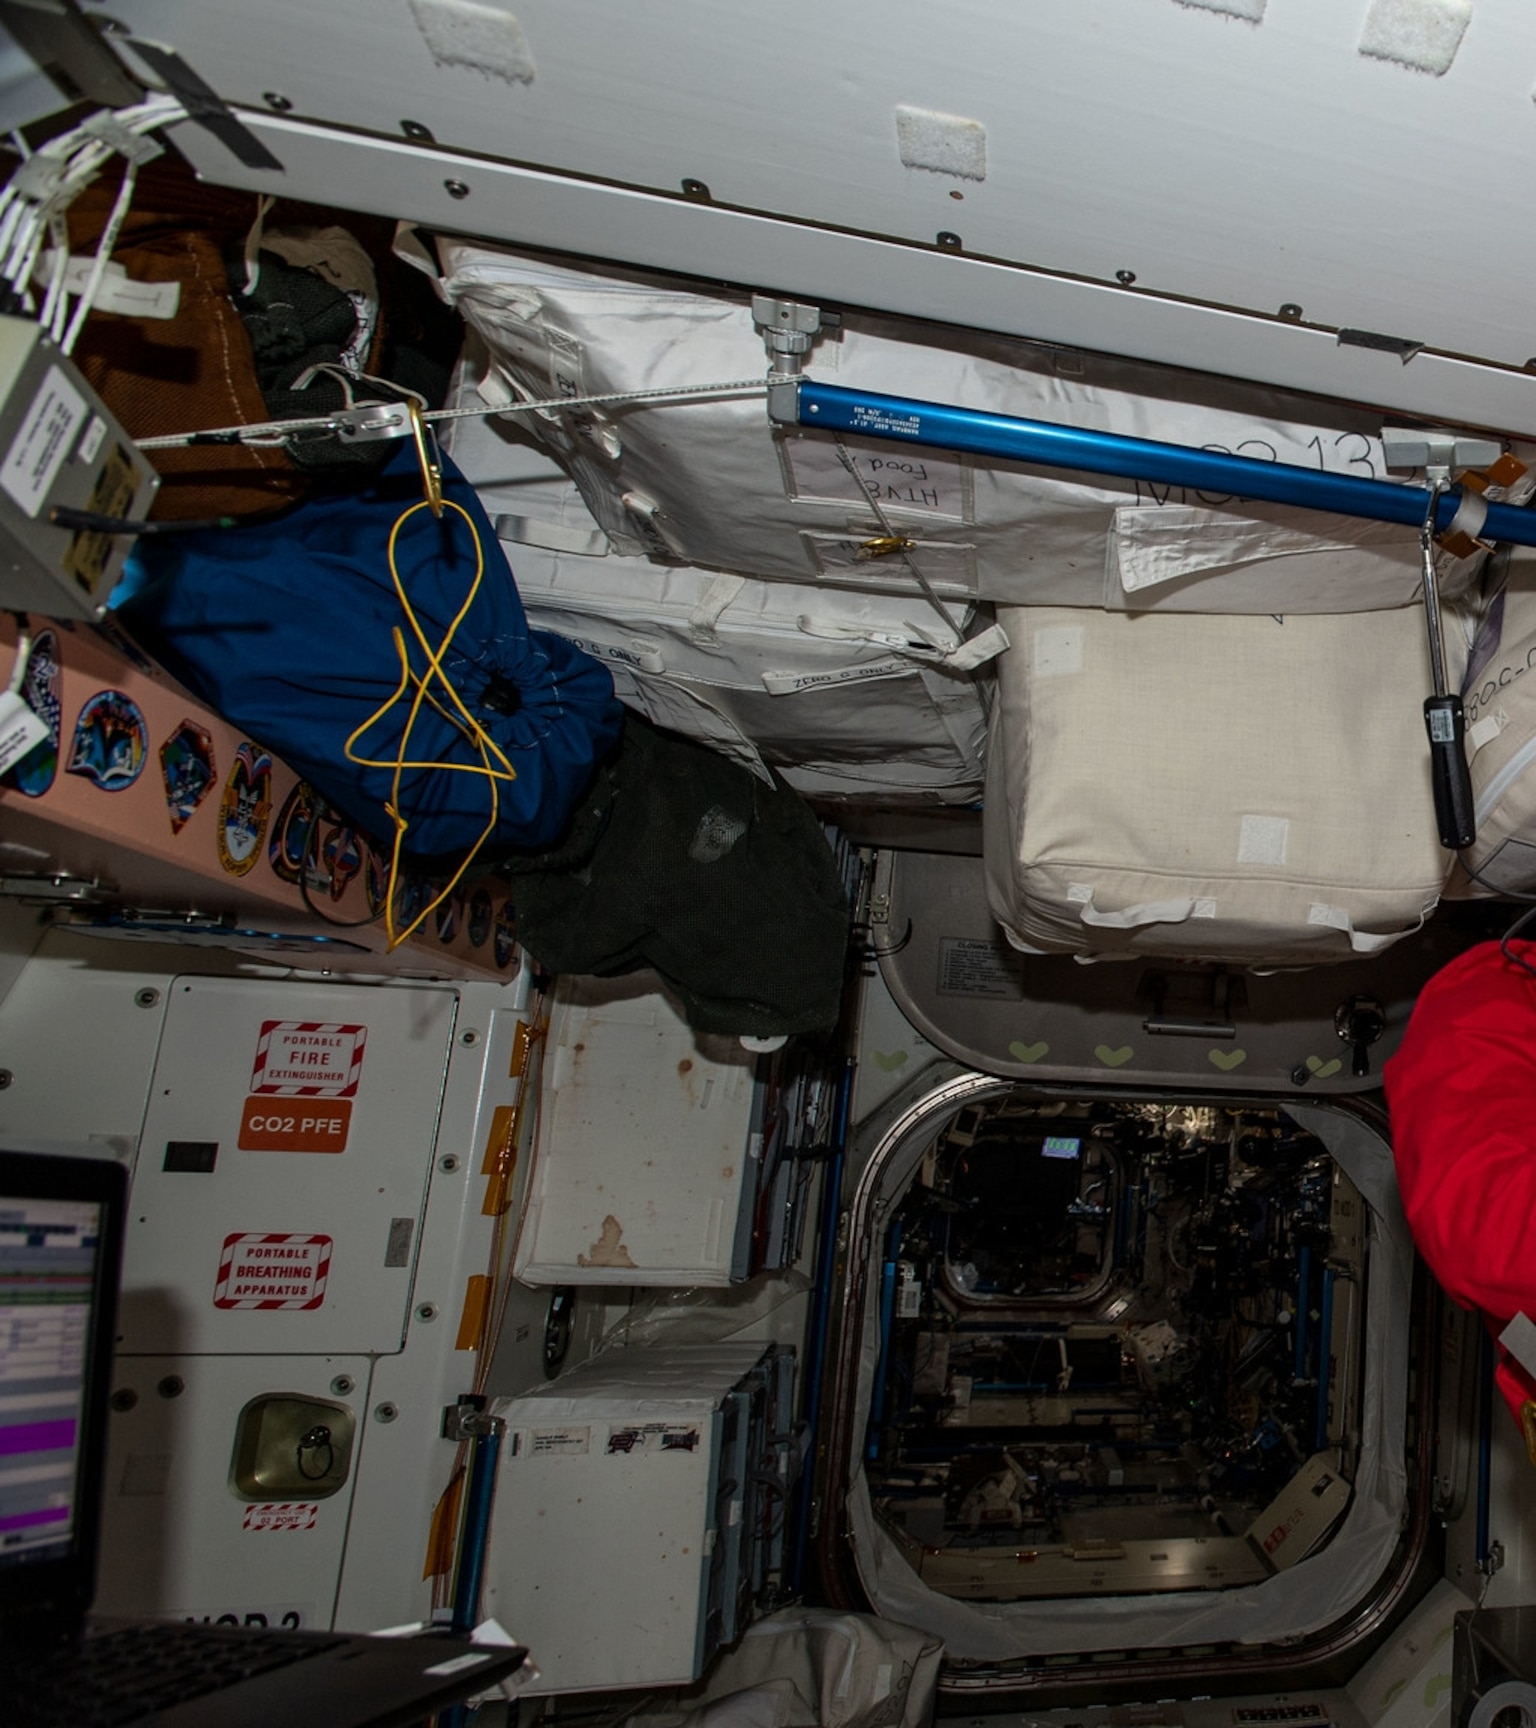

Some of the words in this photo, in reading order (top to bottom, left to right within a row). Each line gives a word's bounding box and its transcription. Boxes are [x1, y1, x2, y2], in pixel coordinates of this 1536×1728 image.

[867, 458, 929, 480] Food
[793, 675, 832, 689] ZERO
[859, 664, 895, 677] ONLY
[283, 1035, 343, 1048] PORTABLE
[289, 1051, 331, 1066] FIRE
[269, 1069, 345, 1082] EXTINGUISHER
[248, 1115, 295, 1132] CO2
[300, 1118, 343, 1135] PFE
[246, 1247, 310, 1260] PORTABLE
[236, 1265, 313, 1280] BREATHING
[233, 1284, 308, 1296] APPARATUS
[275, 1516, 300, 1525] PORT
